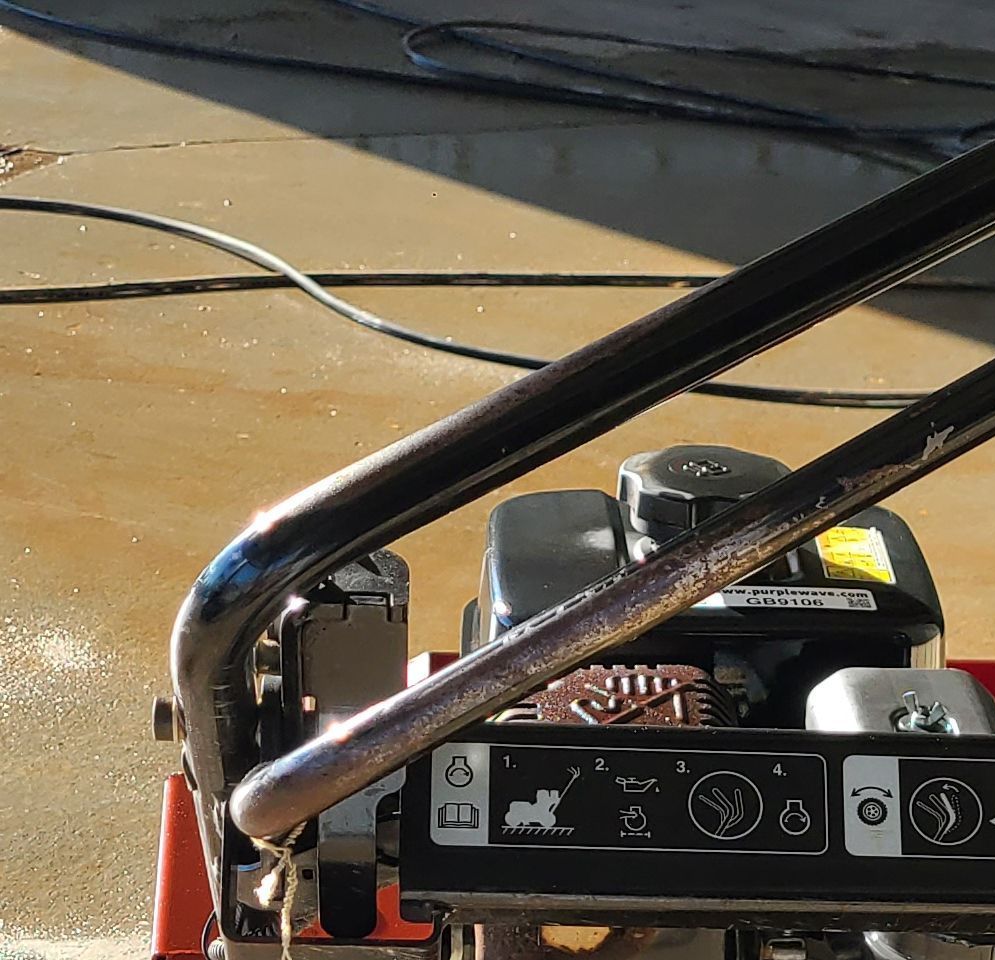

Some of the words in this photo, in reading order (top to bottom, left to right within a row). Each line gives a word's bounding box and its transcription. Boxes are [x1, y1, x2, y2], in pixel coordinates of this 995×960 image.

[721, 588, 869, 599] ww.purplewave.com
[745, 597, 825, 607] GB9106
[502, 755, 517, 768] 1.
[594, 758, 610, 772] 2.
[676, 761, 691, 774] 3.
[772, 764, 787, 777] 4.
